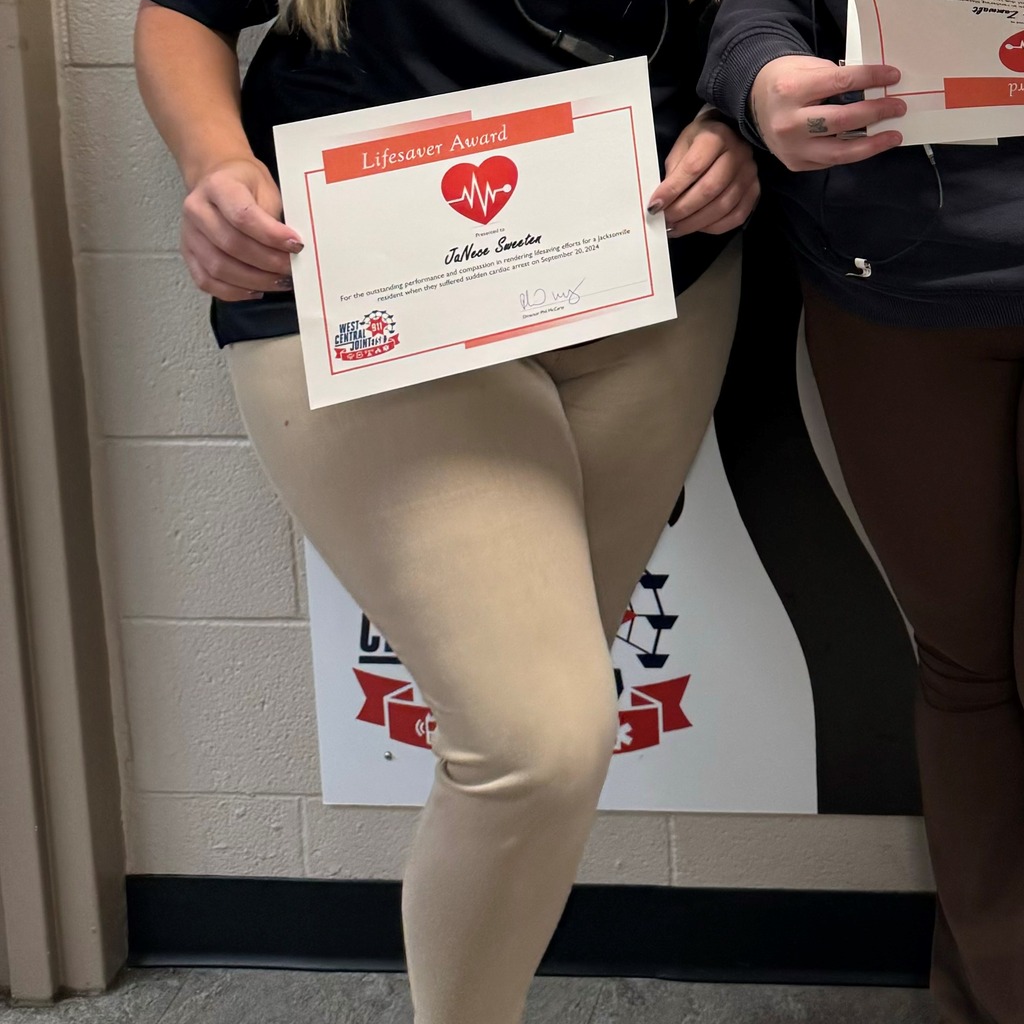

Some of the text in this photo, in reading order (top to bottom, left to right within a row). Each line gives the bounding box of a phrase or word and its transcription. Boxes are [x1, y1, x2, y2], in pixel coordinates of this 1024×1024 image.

[362, 124, 508, 169] Lifesaver Award
[475, 228, 499, 237] Presented
[445, 234, 542, 265] JaNece Sweeten
[366, 283, 403, 296] outstanding
[405, 273, 445, 288] performance
[459, 261, 494, 276] compassion
[504, 251, 533, 264] rendering
[534, 245, 560, 256] lifesaving
[561, 241, 581, 250] efforts
[598, 229, 630, 242] Jacksonville
[377, 292, 403, 302] resident
[405, 287, 422, 295] when
[424, 283, 438, 293] they
[439, 276, 464, 288] suffered
[465, 272, 487, 282] sudden
[489, 266, 510, 276] cardiac
[512, 262, 530, 270] arrest
[541, 251, 573, 263] September
[585, 244, 599, 253] 2024
[339, 320, 359, 334] WEST
[371, 322, 382, 332] 911
[335, 329, 366, 344] CENTRAL
[350, 337, 371, 351] JOINT
